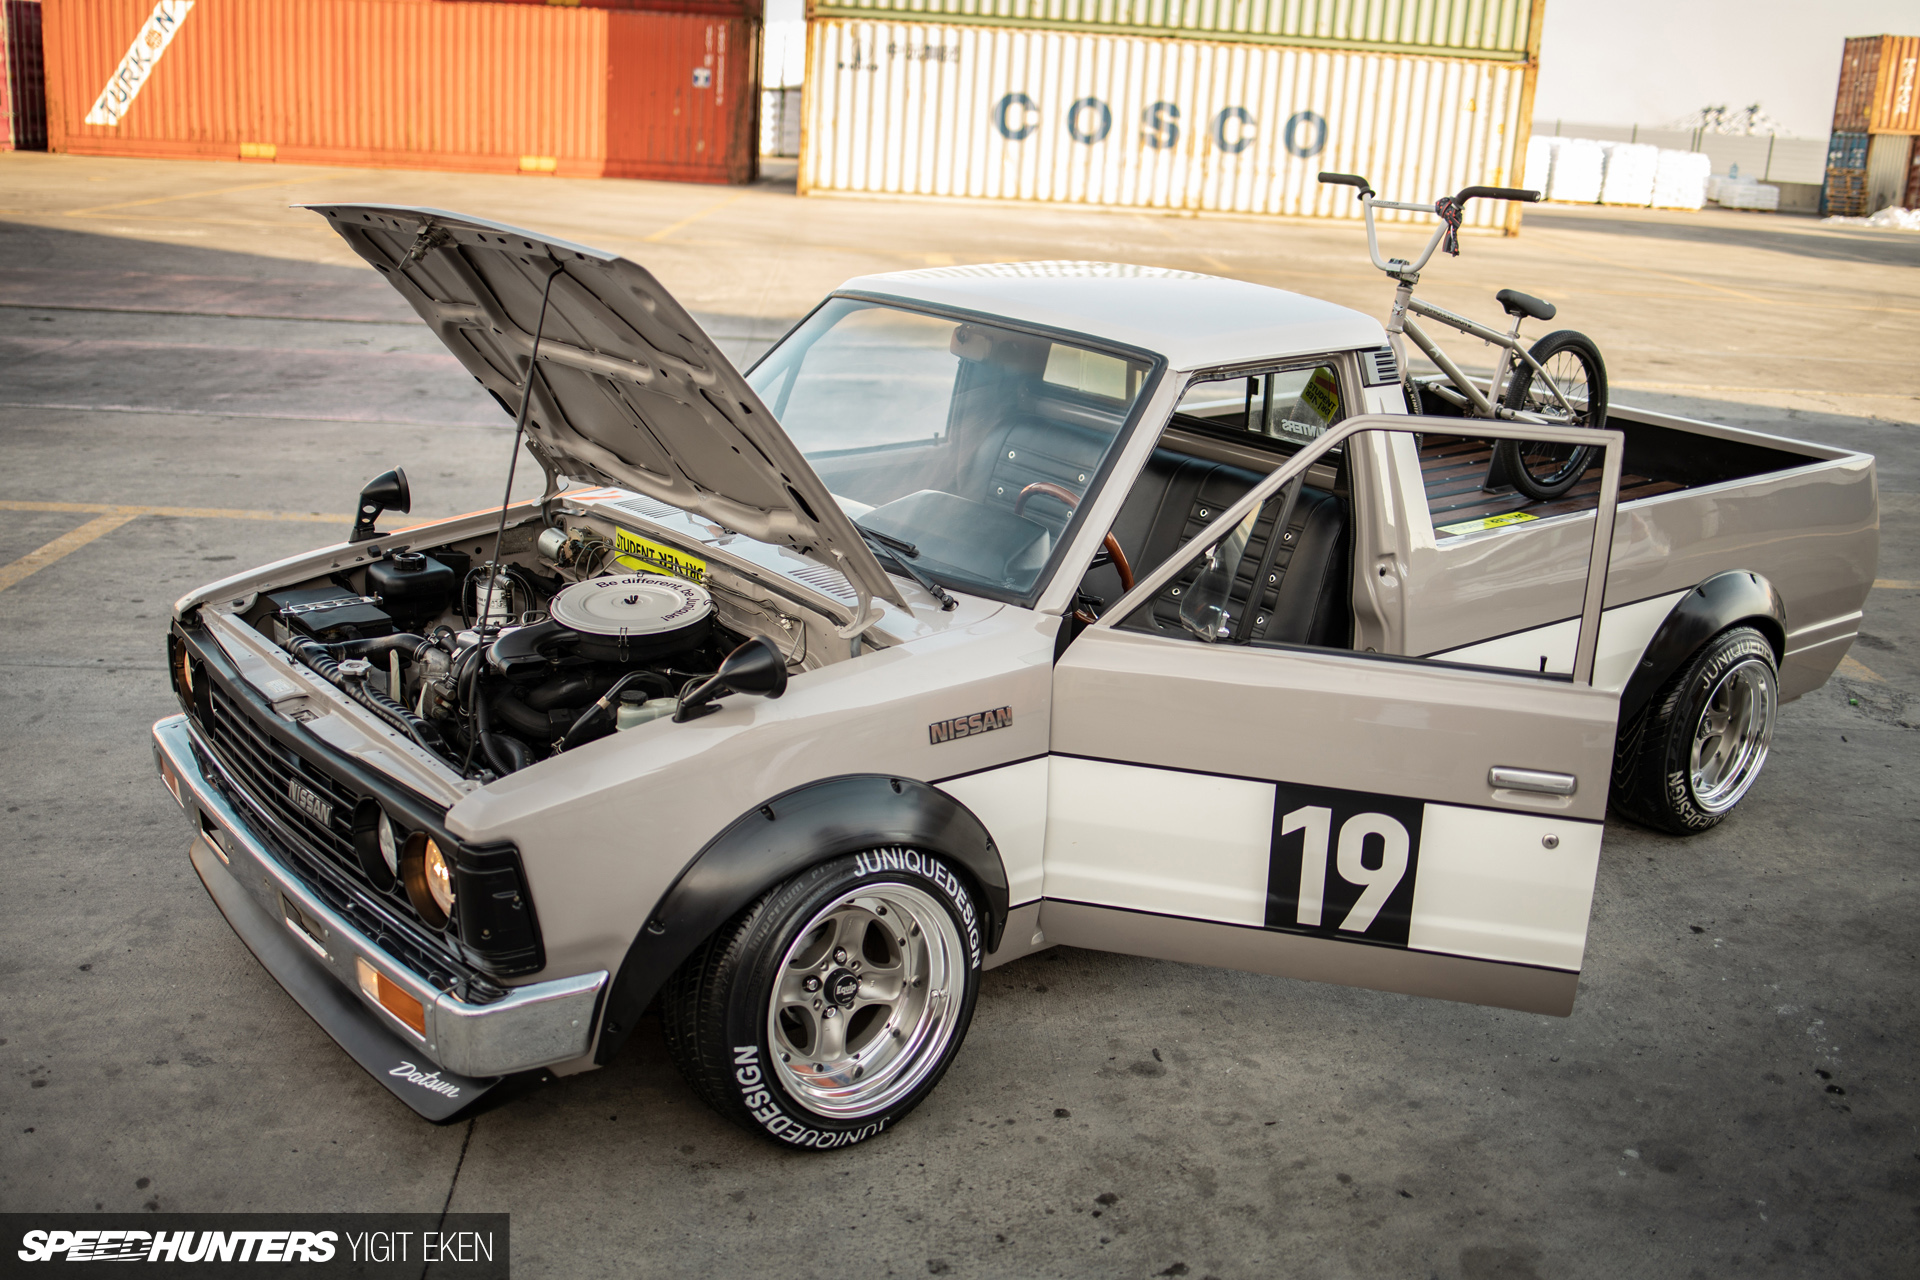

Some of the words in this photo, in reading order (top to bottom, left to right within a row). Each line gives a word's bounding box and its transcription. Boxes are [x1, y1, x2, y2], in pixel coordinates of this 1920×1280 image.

[993, 91, 1328, 159] COSCO
[1307, 381, 1337, 410] STUDENT
[616, 532, 656, 561] STUDENT
[595, 580, 619, 588] Be
[680, 588, 695, 597] be
[930, 706, 1013, 744] NISSAN
[289, 779, 330, 827] NISSAN
[1281, 805, 1410, 933] 19
[854, 847, 981, 970] JUNIQUEDESIGN
[836, 981, 857, 996] Equip
[389, 1060, 460, 1098] Datsun
[733, 1045, 891, 1149] JUNIQUEDESIGN
